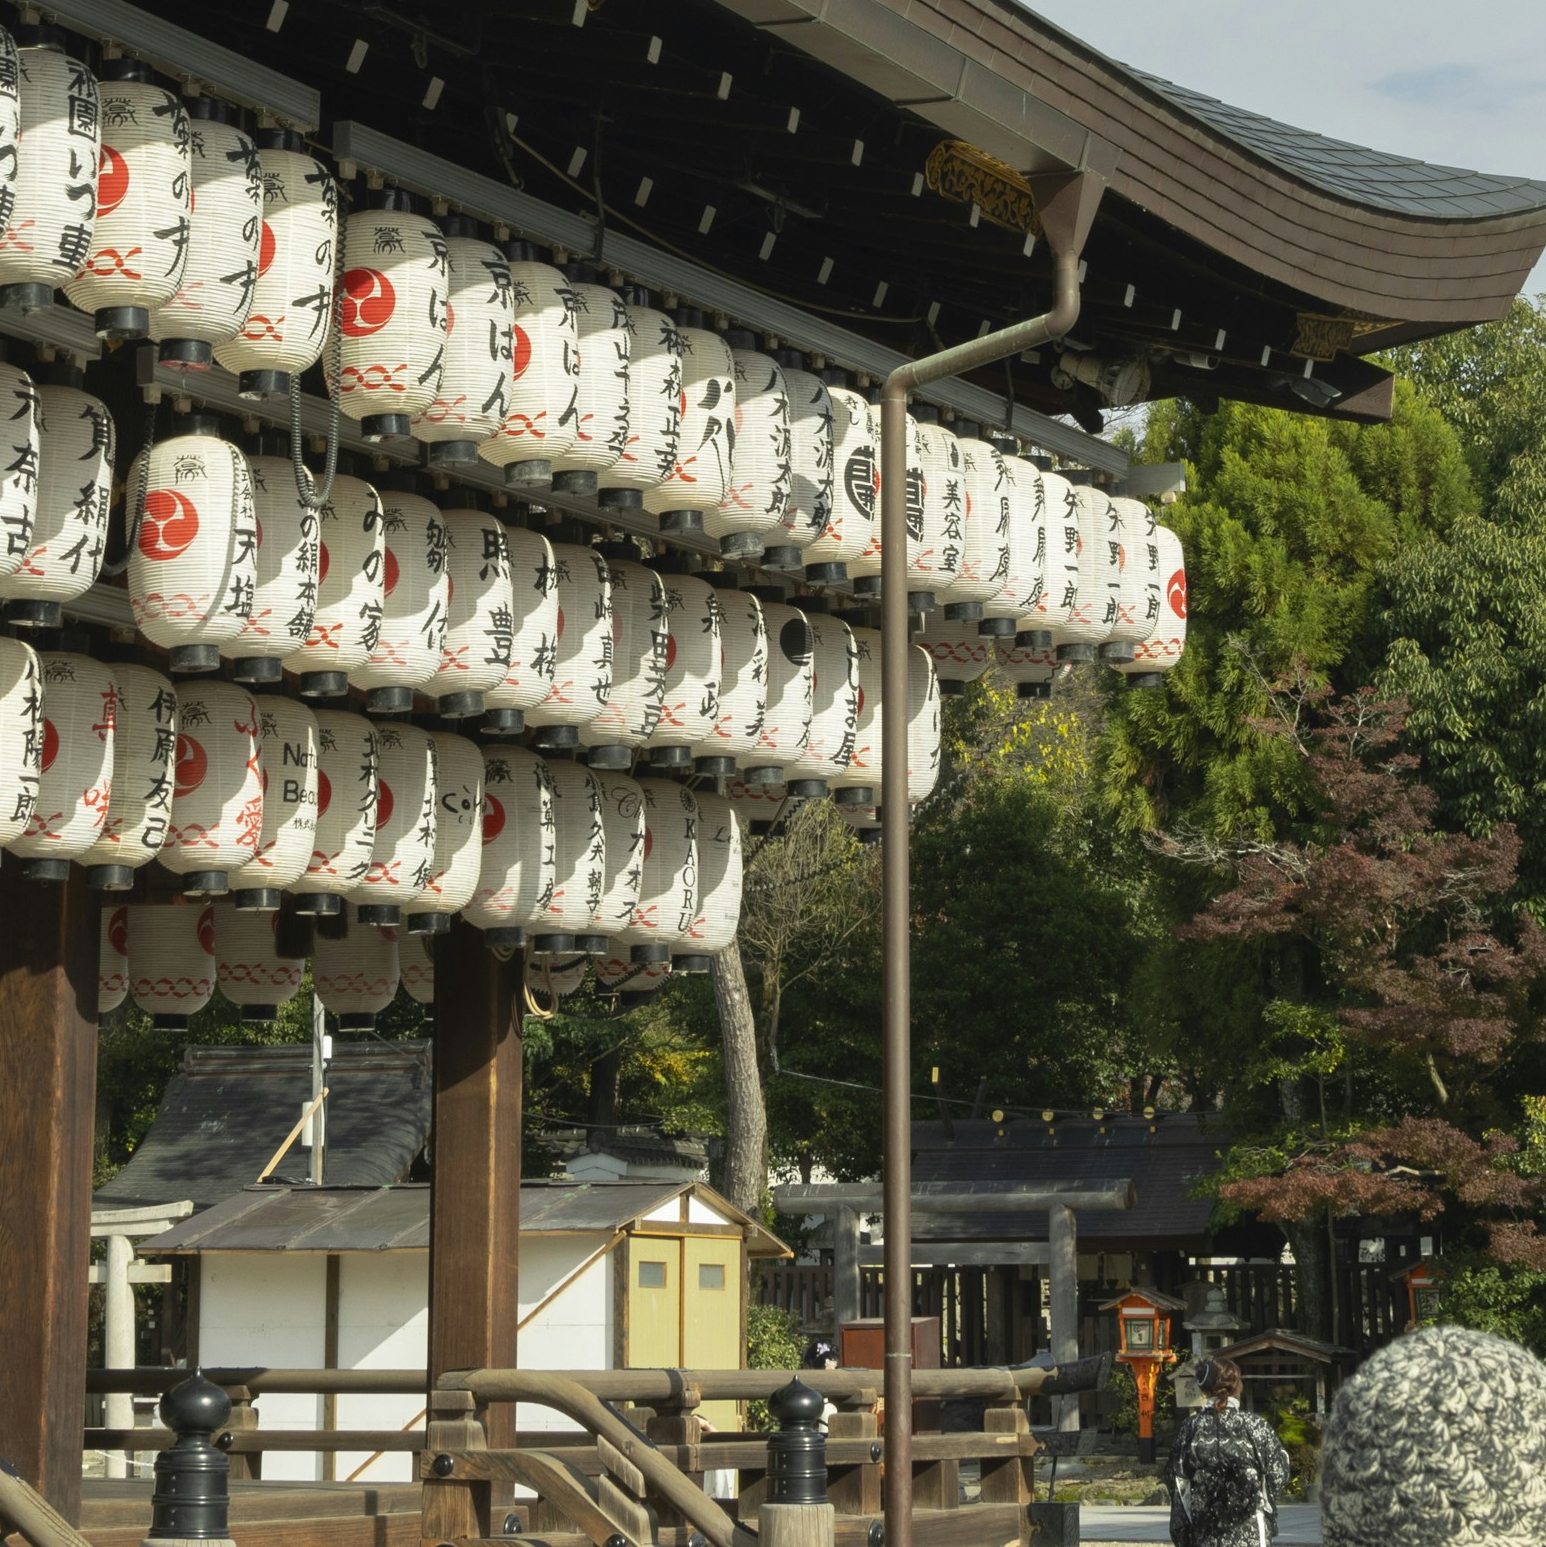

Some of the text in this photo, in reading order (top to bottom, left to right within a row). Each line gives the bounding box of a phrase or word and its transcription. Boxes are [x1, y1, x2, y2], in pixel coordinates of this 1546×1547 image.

[938, 478, 962, 572] 美容室
[677, 818, 696, 932] KAORU
